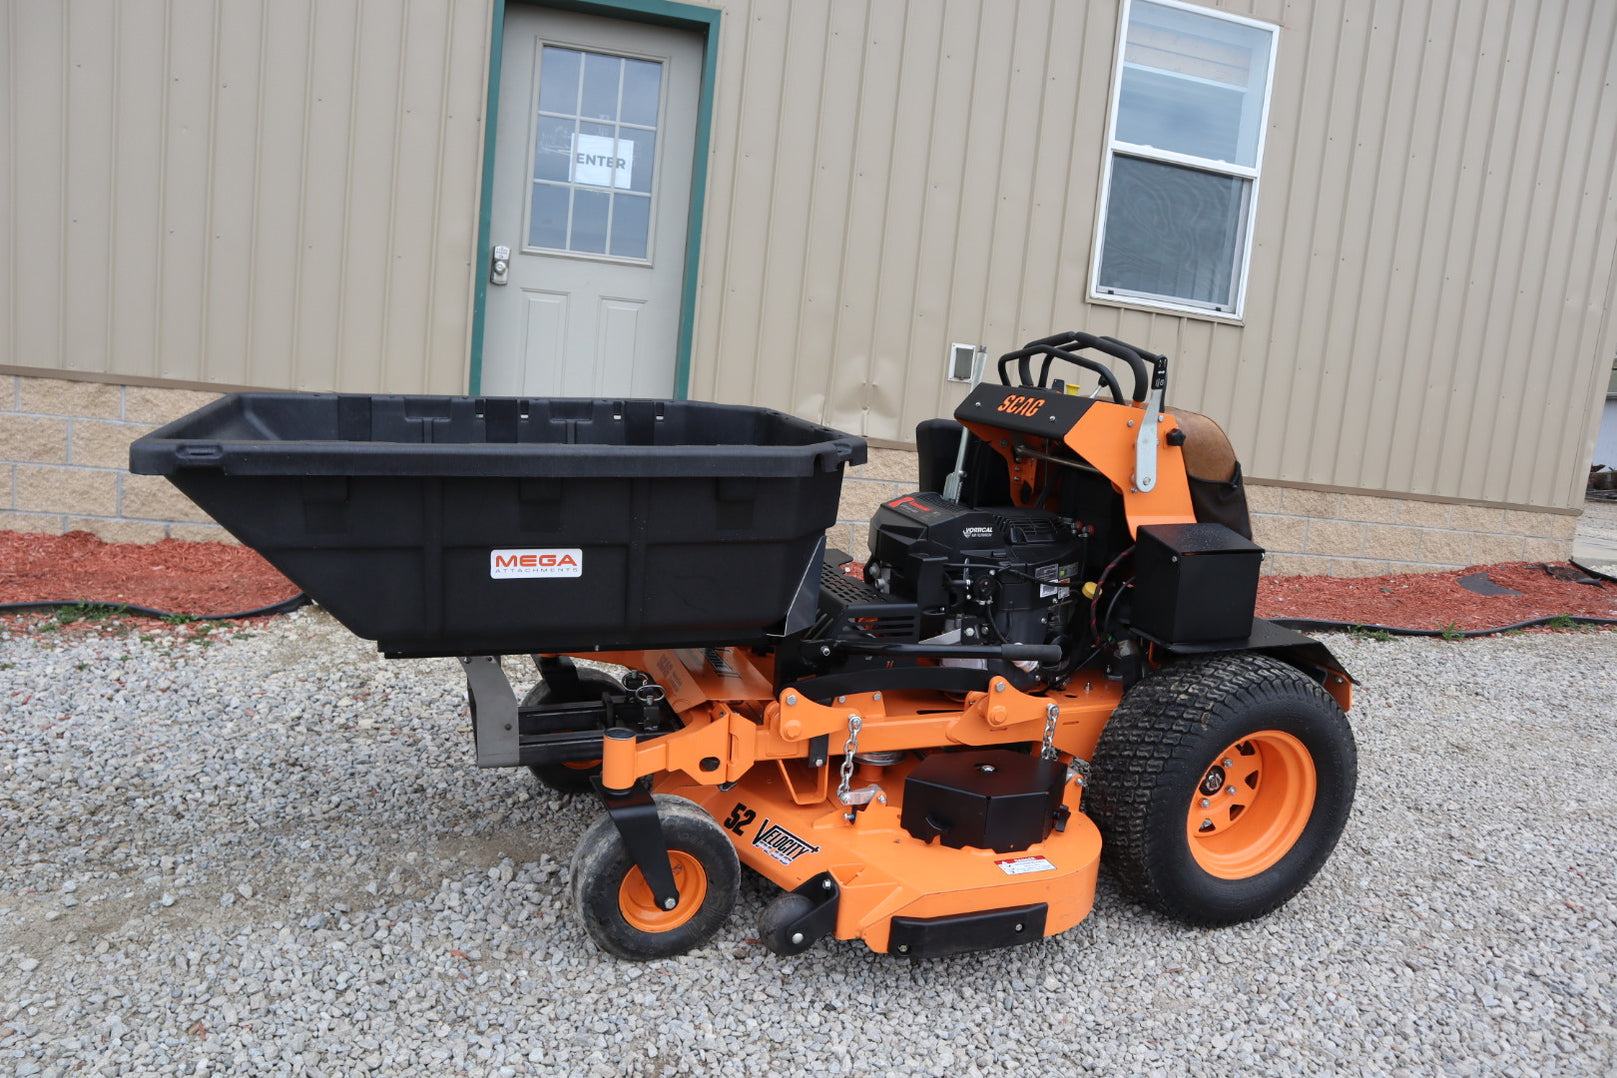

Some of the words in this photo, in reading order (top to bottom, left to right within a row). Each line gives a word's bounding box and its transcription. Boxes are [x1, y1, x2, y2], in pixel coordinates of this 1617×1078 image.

[576, 153, 626, 169] ENTER
[997, 394, 1046, 417] SCAG
[495, 554, 578, 567] MEGA
[723, 802, 756, 837] 52
[752, 818, 820, 860] VELOCITY
